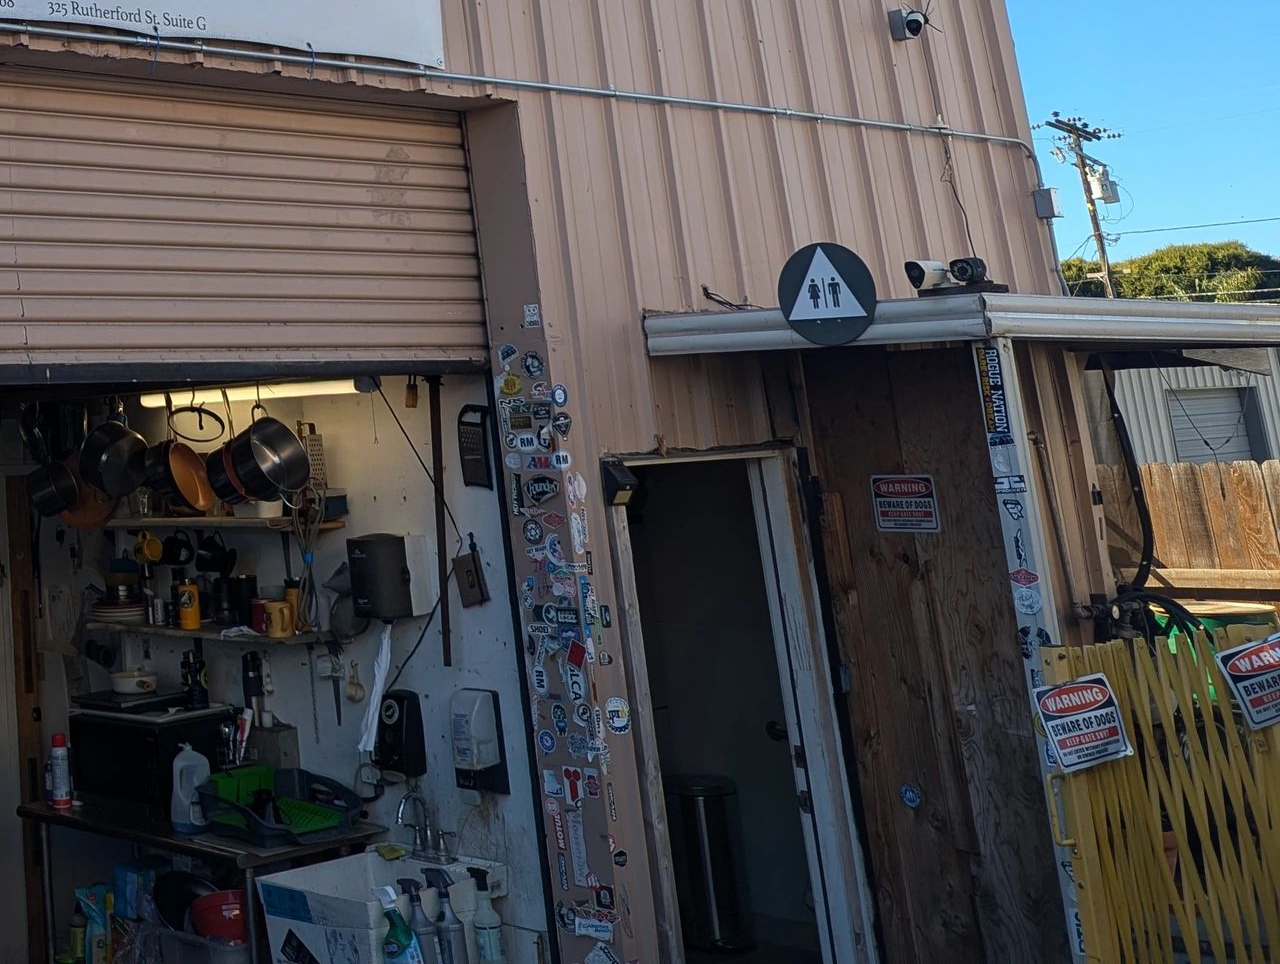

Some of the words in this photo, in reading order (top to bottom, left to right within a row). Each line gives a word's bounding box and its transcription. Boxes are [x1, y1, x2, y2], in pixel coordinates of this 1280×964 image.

[47, 1, 68, 17] 325
[70, 0, 142, 24] Rutherford
[144, 10, 161, 26] St.
[162, 12, 194, 30] Suite
[196, 16, 207, 31] G
[985, 347, 1002, 386] ROGUE
[991, 389, 1009, 433] NATION
[520, 437, 535, 448] RM
[555, 454, 569, 465] RM
[879, 483, 926, 493] WARNING
[878, 500, 904, 509] BEWARE
[904, 500, 913, 509] OF
[914, 500, 932, 509] DOGS
[535, 670, 546, 689] RM
[1045, 687, 1104, 712] WARNING
[1051, 719, 1083, 737] BEWARE
[1082, 716, 1094, 730] OF
[1094, 711, 1116, 727] DOGS
[553, 814, 567, 849] MOTUL
